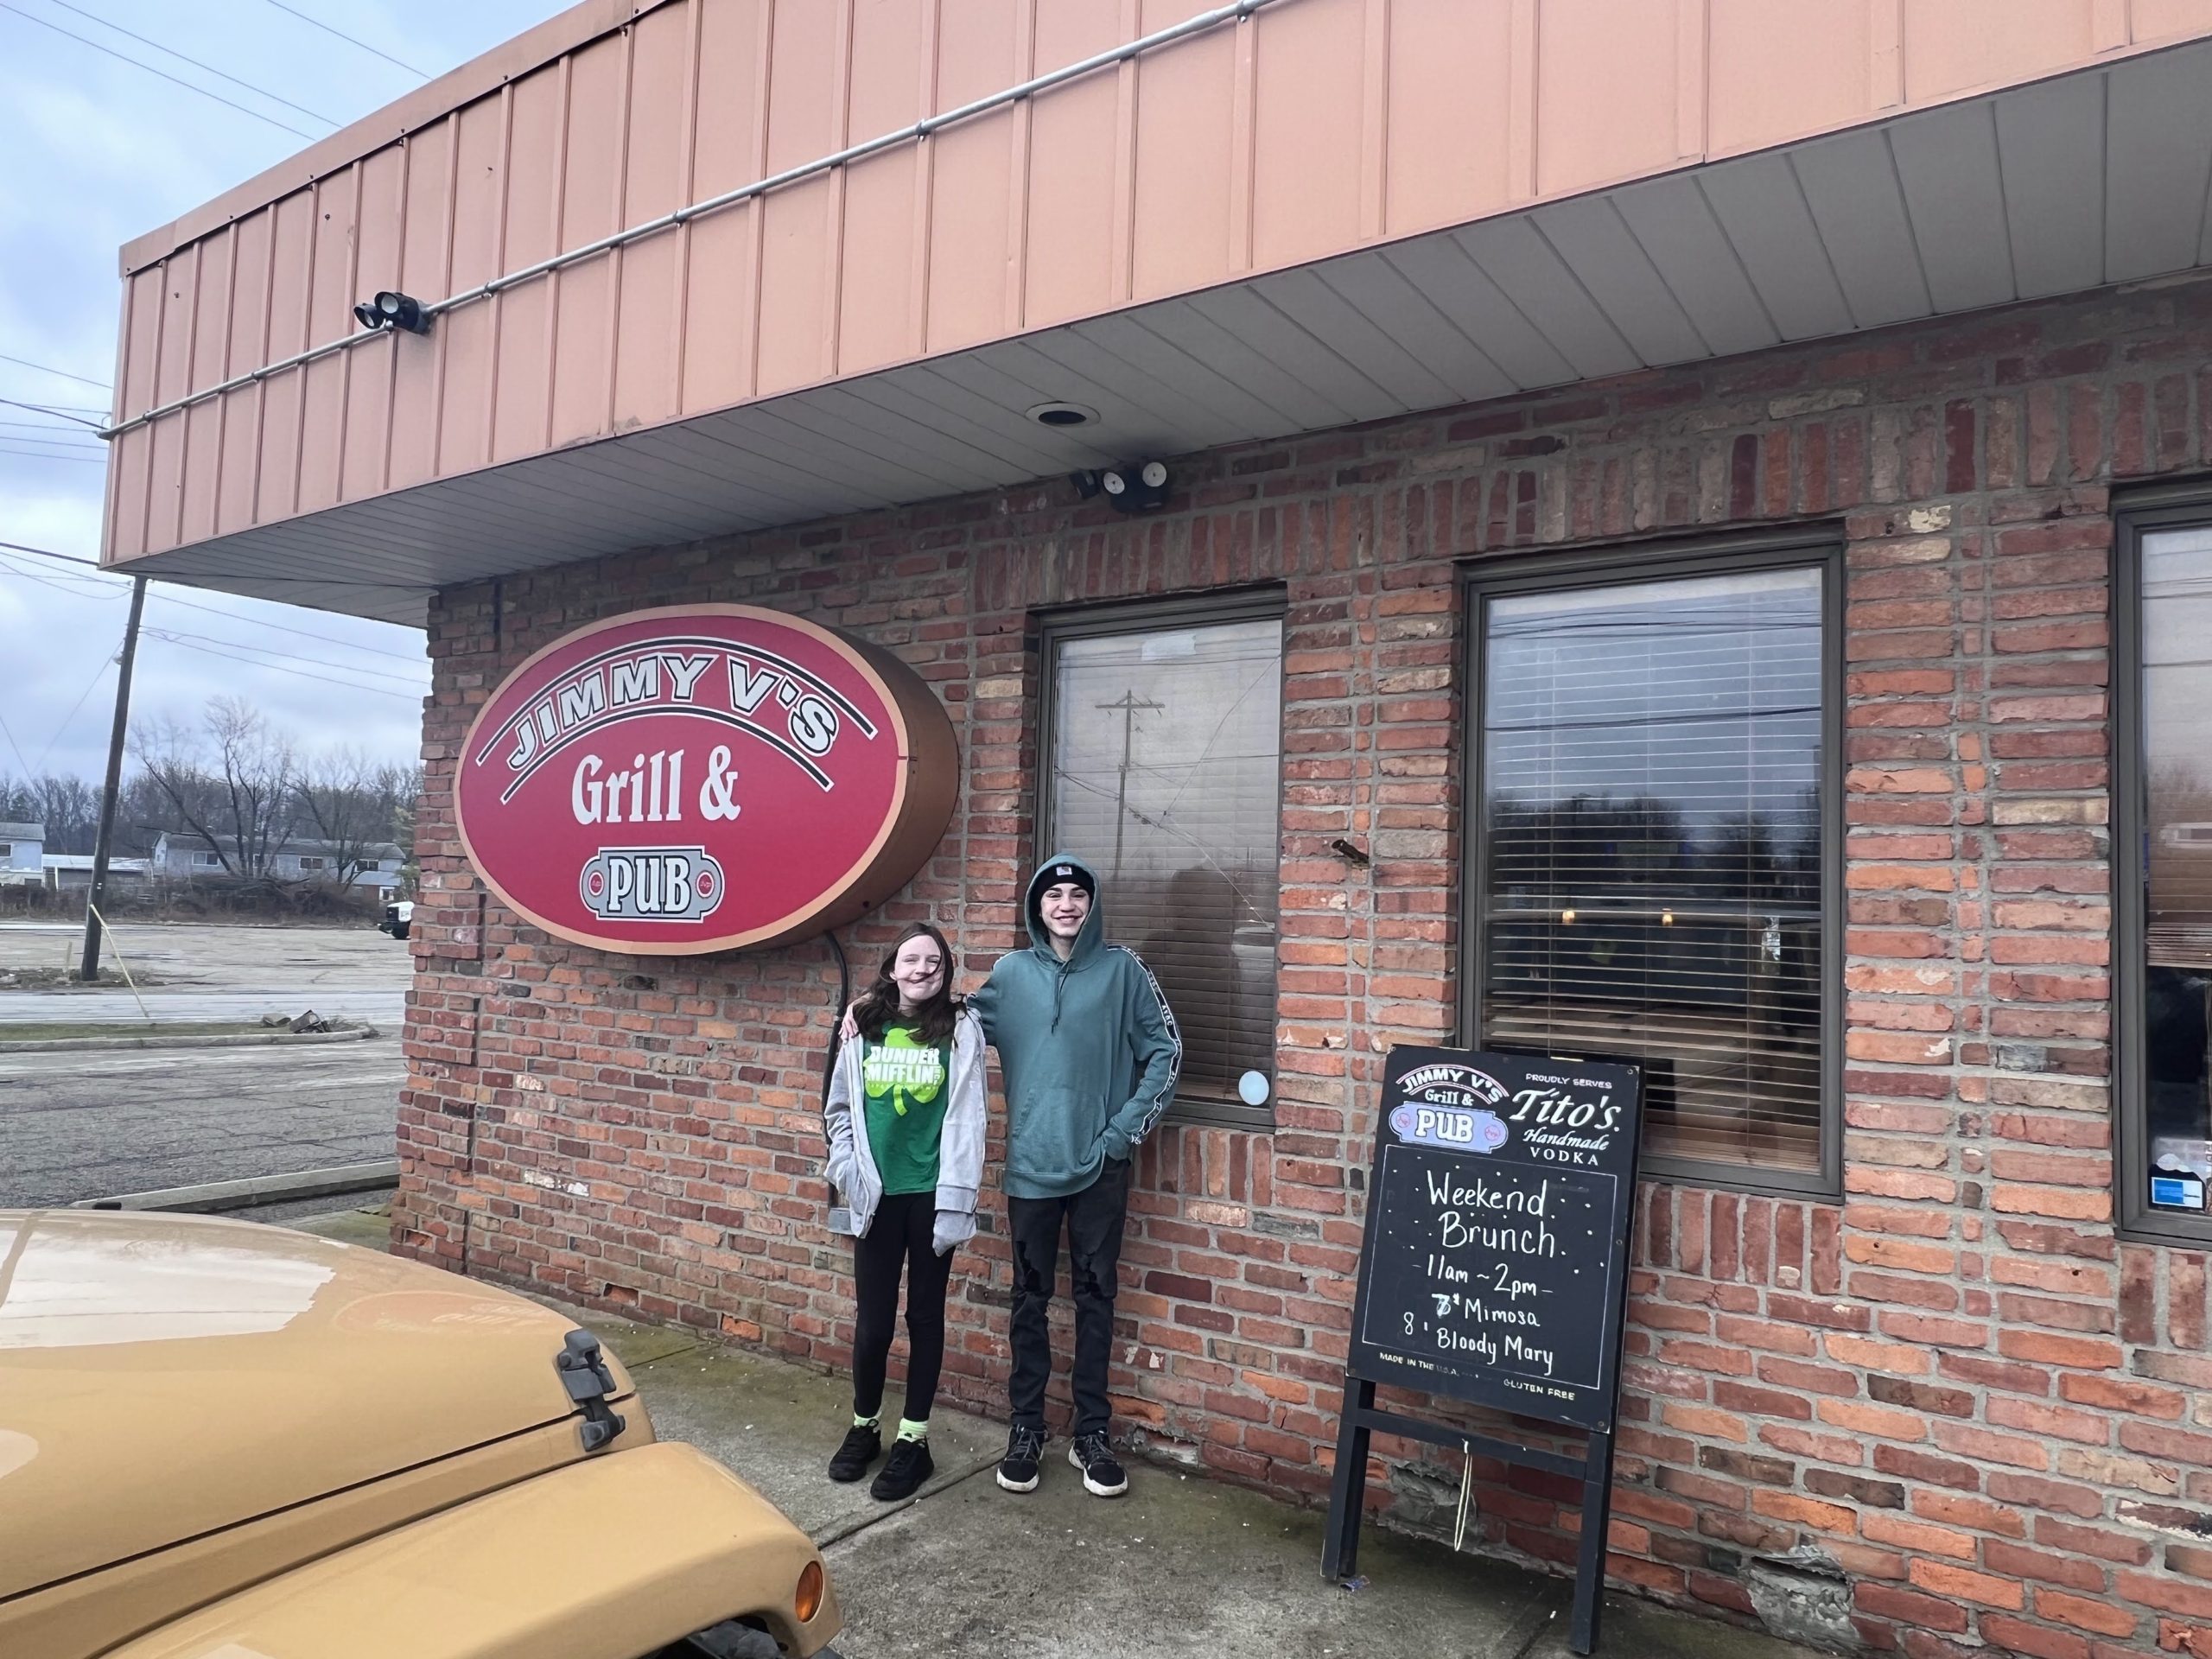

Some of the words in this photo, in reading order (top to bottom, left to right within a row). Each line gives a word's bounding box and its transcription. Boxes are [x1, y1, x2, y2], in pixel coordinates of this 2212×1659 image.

[508, 653, 719, 769] JIMMY
[728, 655, 839, 757] V'S
[572, 749, 684, 824] Grill
[699, 745, 741, 821] &
[607, 855, 691, 914] PUB
[871, 1046, 939, 1065] DUNDER
[867, 1064, 934, 1084] MIFFLIN
[1402, 1068, 1465, 1093] JIMMY
[1471, 1074, 1503, 1103] V'S
[1526, 1073, 1570, 1084] PROUDLY
[1573, 1078, 1612, 1089] SERVES
[1424, 1089, 1459, 1104] Grill
[1461, 1093, 1474, 1106] &
[1414, 1109, 1473, 1142] PUB
[1522, 1126, 1610, 1150] Handmade
[1530, 1147, 1599, 1166] VODKA
[1427, 1170, 1547, 1217] Weekend
[1438, 1211, 1554, 1258] Brunch
[1427, 1254, 1468, 1283] 11am
[1494, 1263, 1536, 1300] 2pm
[1465, 1298, 1541, 1327] Mimosa
[1379, 1351, 1403, 1364] MADE
[1418, 1360, 1434, 1370] THE
[1437, 1327, 1497, 1365] Bloody
[1504, 1335, 1553, 1376] Mary
[1503, 1378, 1543, 1394] GLUTEN
[1548, 1388, 1575, 1401] FREE
